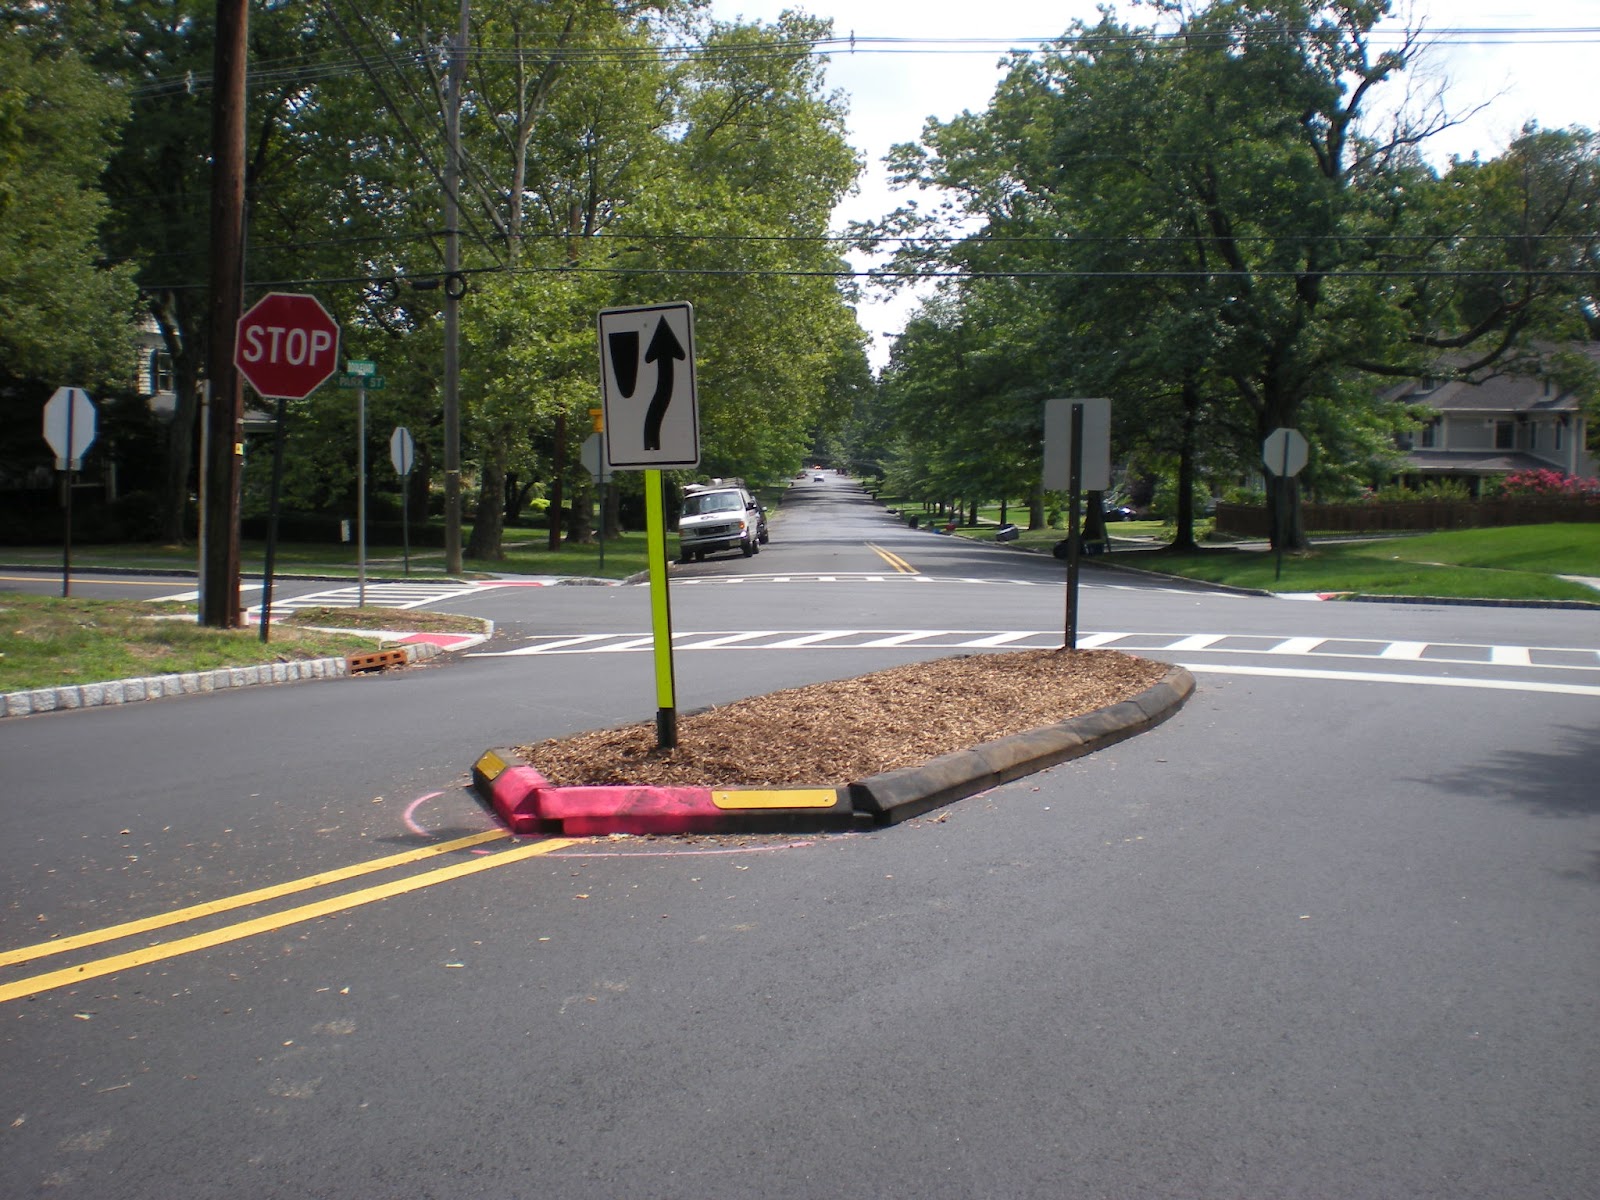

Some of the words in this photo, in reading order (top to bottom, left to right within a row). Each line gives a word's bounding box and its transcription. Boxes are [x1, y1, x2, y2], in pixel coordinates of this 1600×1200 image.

[243, 325, 331, 366] STOP
[339, 377, 364, 387] PARK
[369, 377, 383, 388] ST
